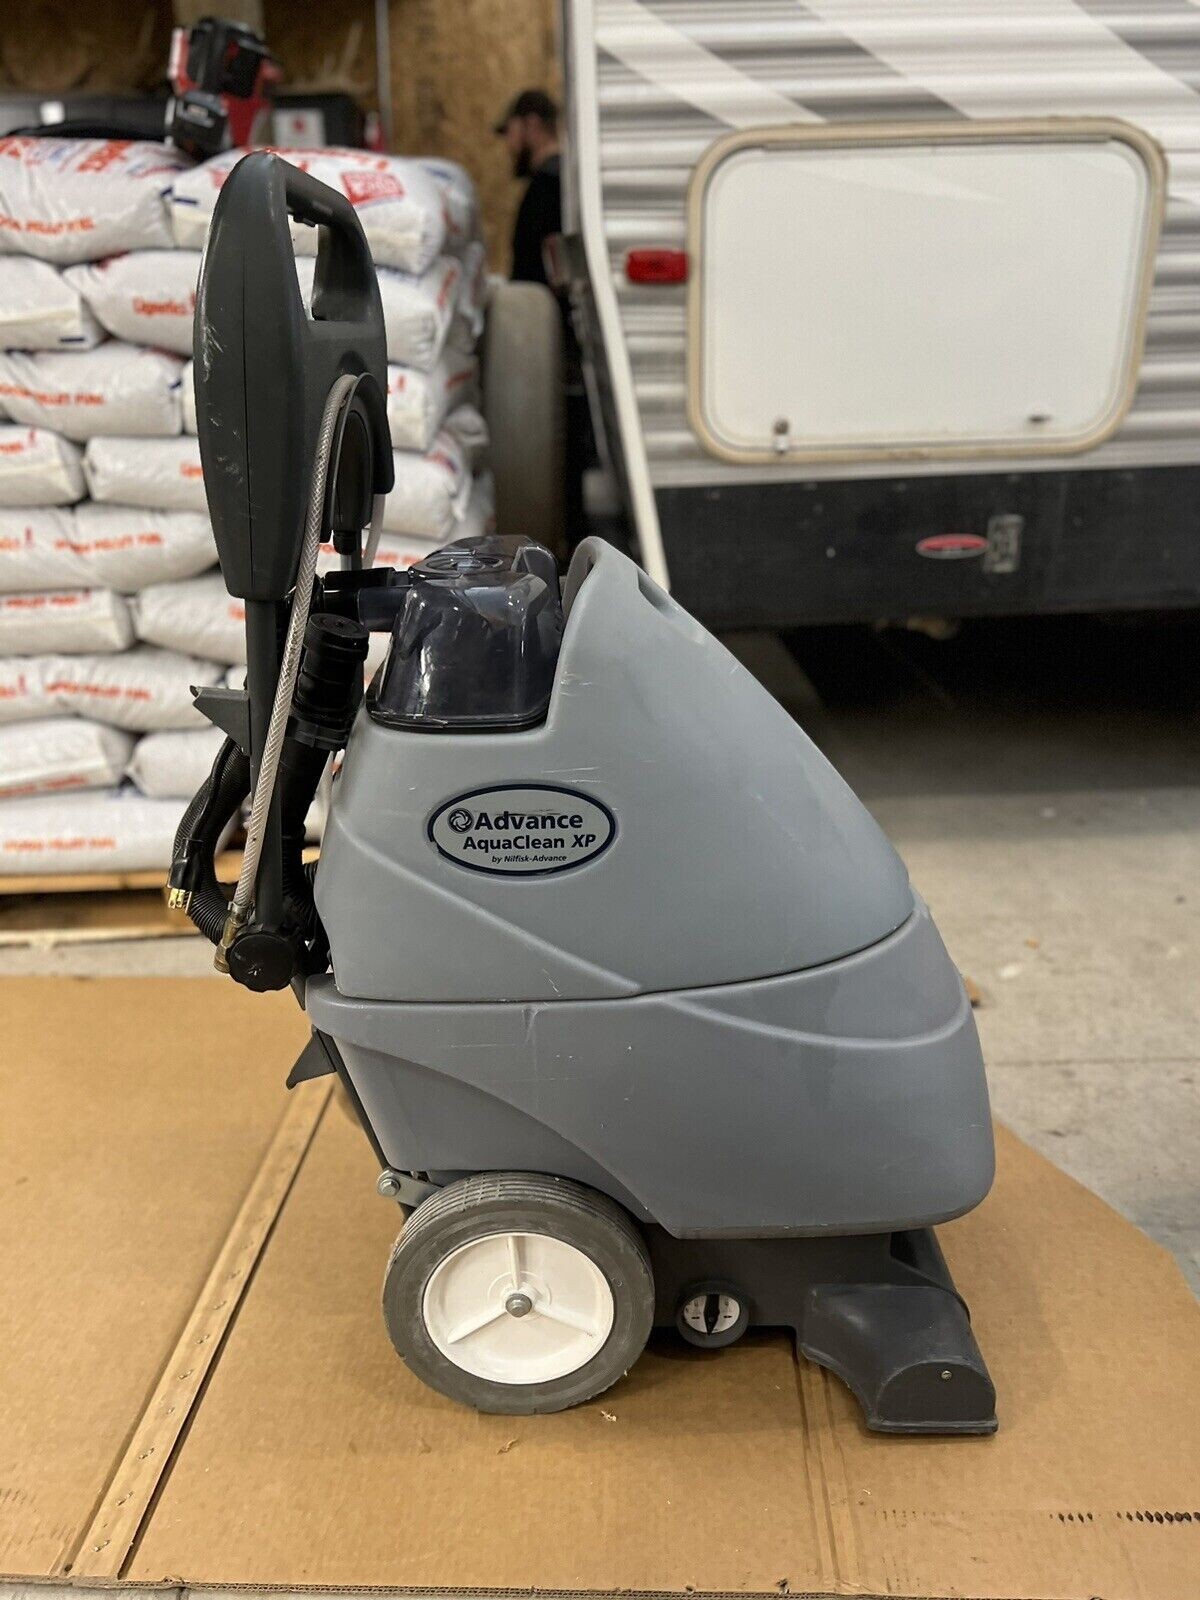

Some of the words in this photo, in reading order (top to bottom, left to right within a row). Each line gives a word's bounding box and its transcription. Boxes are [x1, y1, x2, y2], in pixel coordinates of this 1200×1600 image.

[474, 811, 583, 831] Advance
[462, 835, 565, 853] AquaClean
[570, 834, 596, 848] XP
[491, 855, 502, 864] by
[503, 855, 567, 863] Nilfisk-Advance
